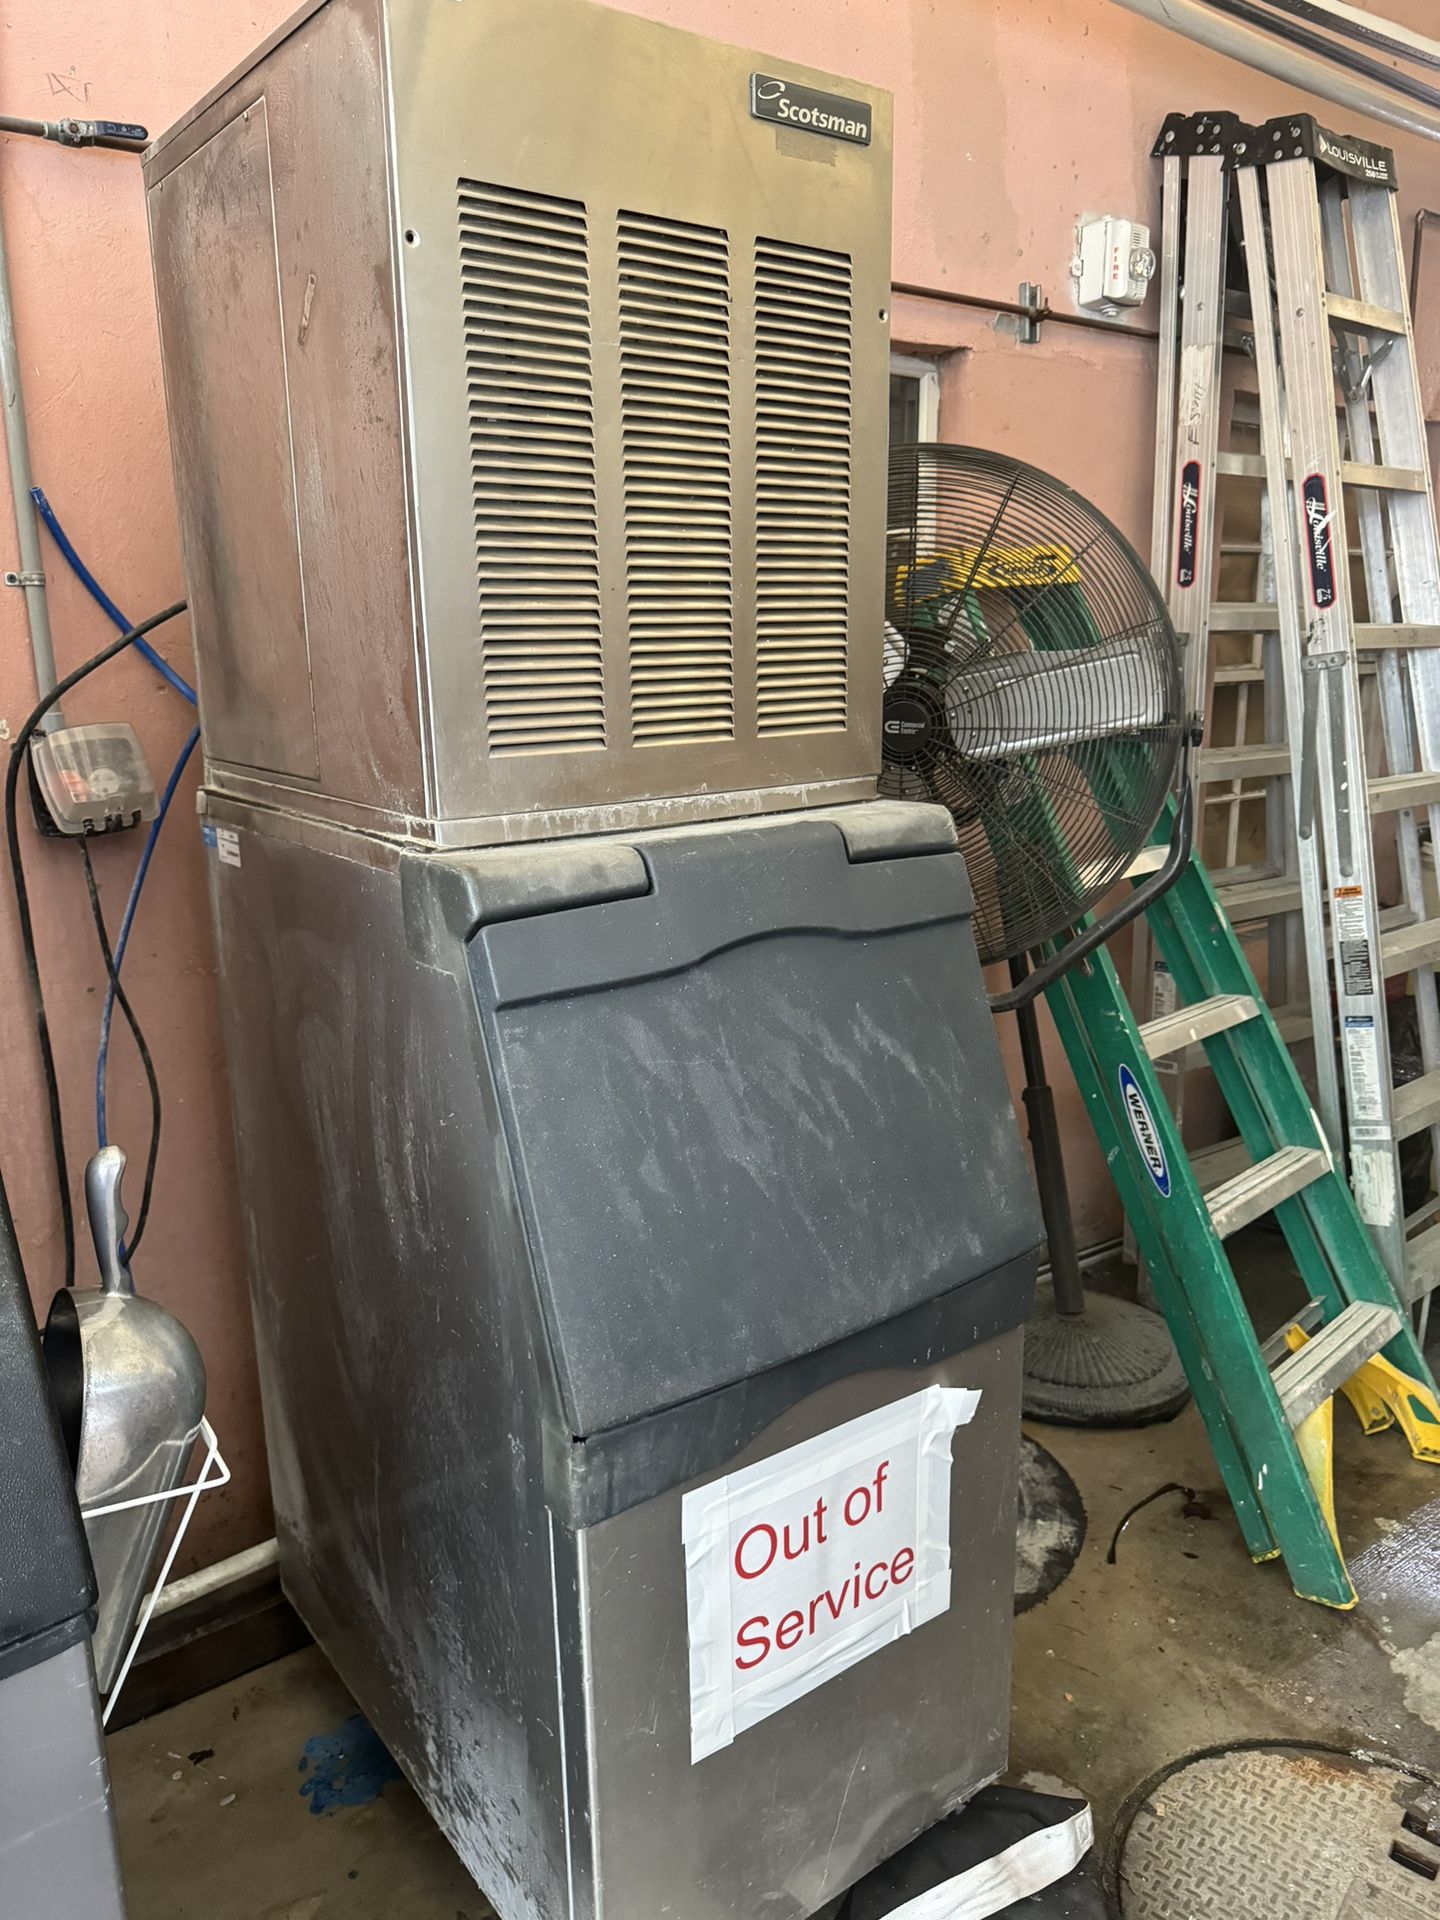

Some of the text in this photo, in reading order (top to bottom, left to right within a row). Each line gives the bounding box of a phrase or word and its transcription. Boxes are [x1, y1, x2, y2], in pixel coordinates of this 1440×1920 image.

[777, 98, 867, 138] Scotsman
[1327, 142, 1387, 172] LOUISVILLE
[1183, 482, 1198, 553] Louisville
[1128, 1093, 1162, 1169] WERNER
[734, 1460, 890, 1580] Out of
[734, 1546, 915, 1670] Service
